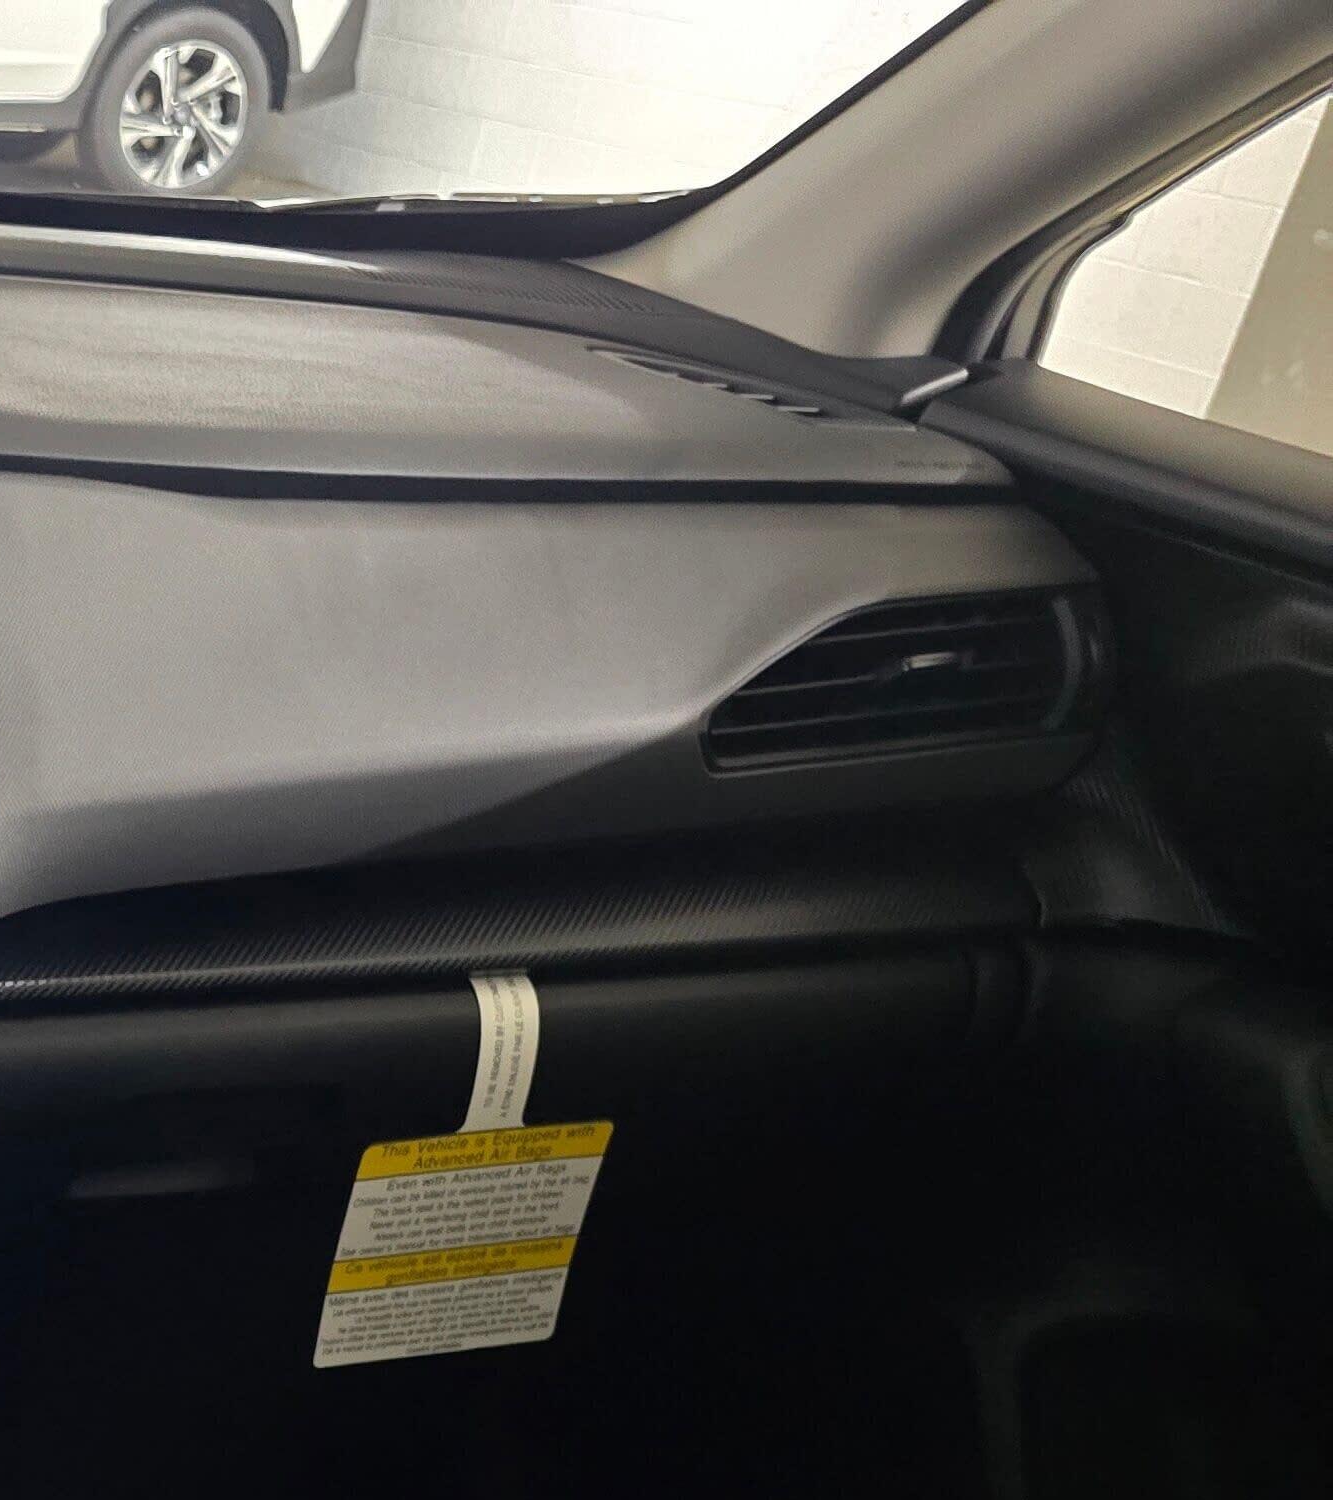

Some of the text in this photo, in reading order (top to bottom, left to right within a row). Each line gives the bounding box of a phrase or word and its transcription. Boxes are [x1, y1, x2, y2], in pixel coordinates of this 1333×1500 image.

[383, 1126, 595, 1158] This Vehicle is Equipped with
[413, 1146, 552, 1170] Advanced Air Bags
[387, 1164, 566, 1191] Even with Advanced Air Bags
